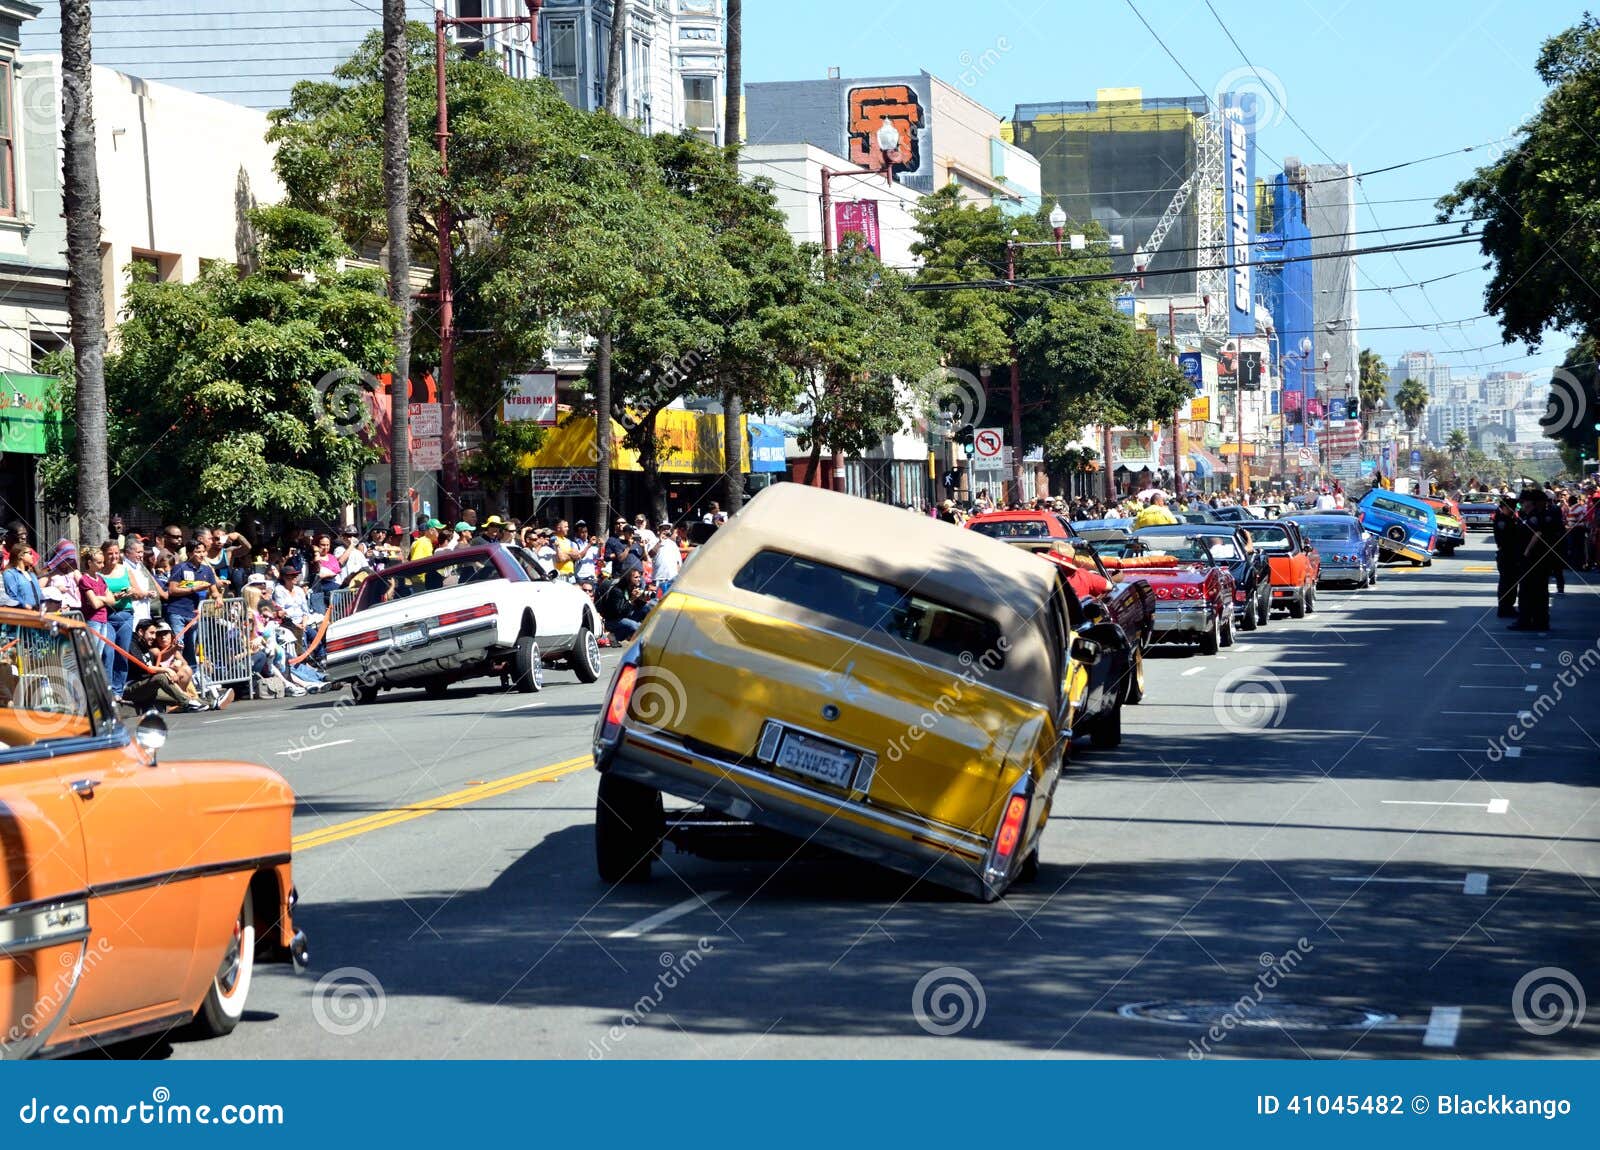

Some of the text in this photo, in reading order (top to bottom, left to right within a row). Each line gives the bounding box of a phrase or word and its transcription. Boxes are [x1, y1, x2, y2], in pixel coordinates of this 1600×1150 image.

[867, 203, 876, 247] community
[1230, 119, 1252, 315] SKECHERS
[785, 746, 850, 781] 5YNW557
